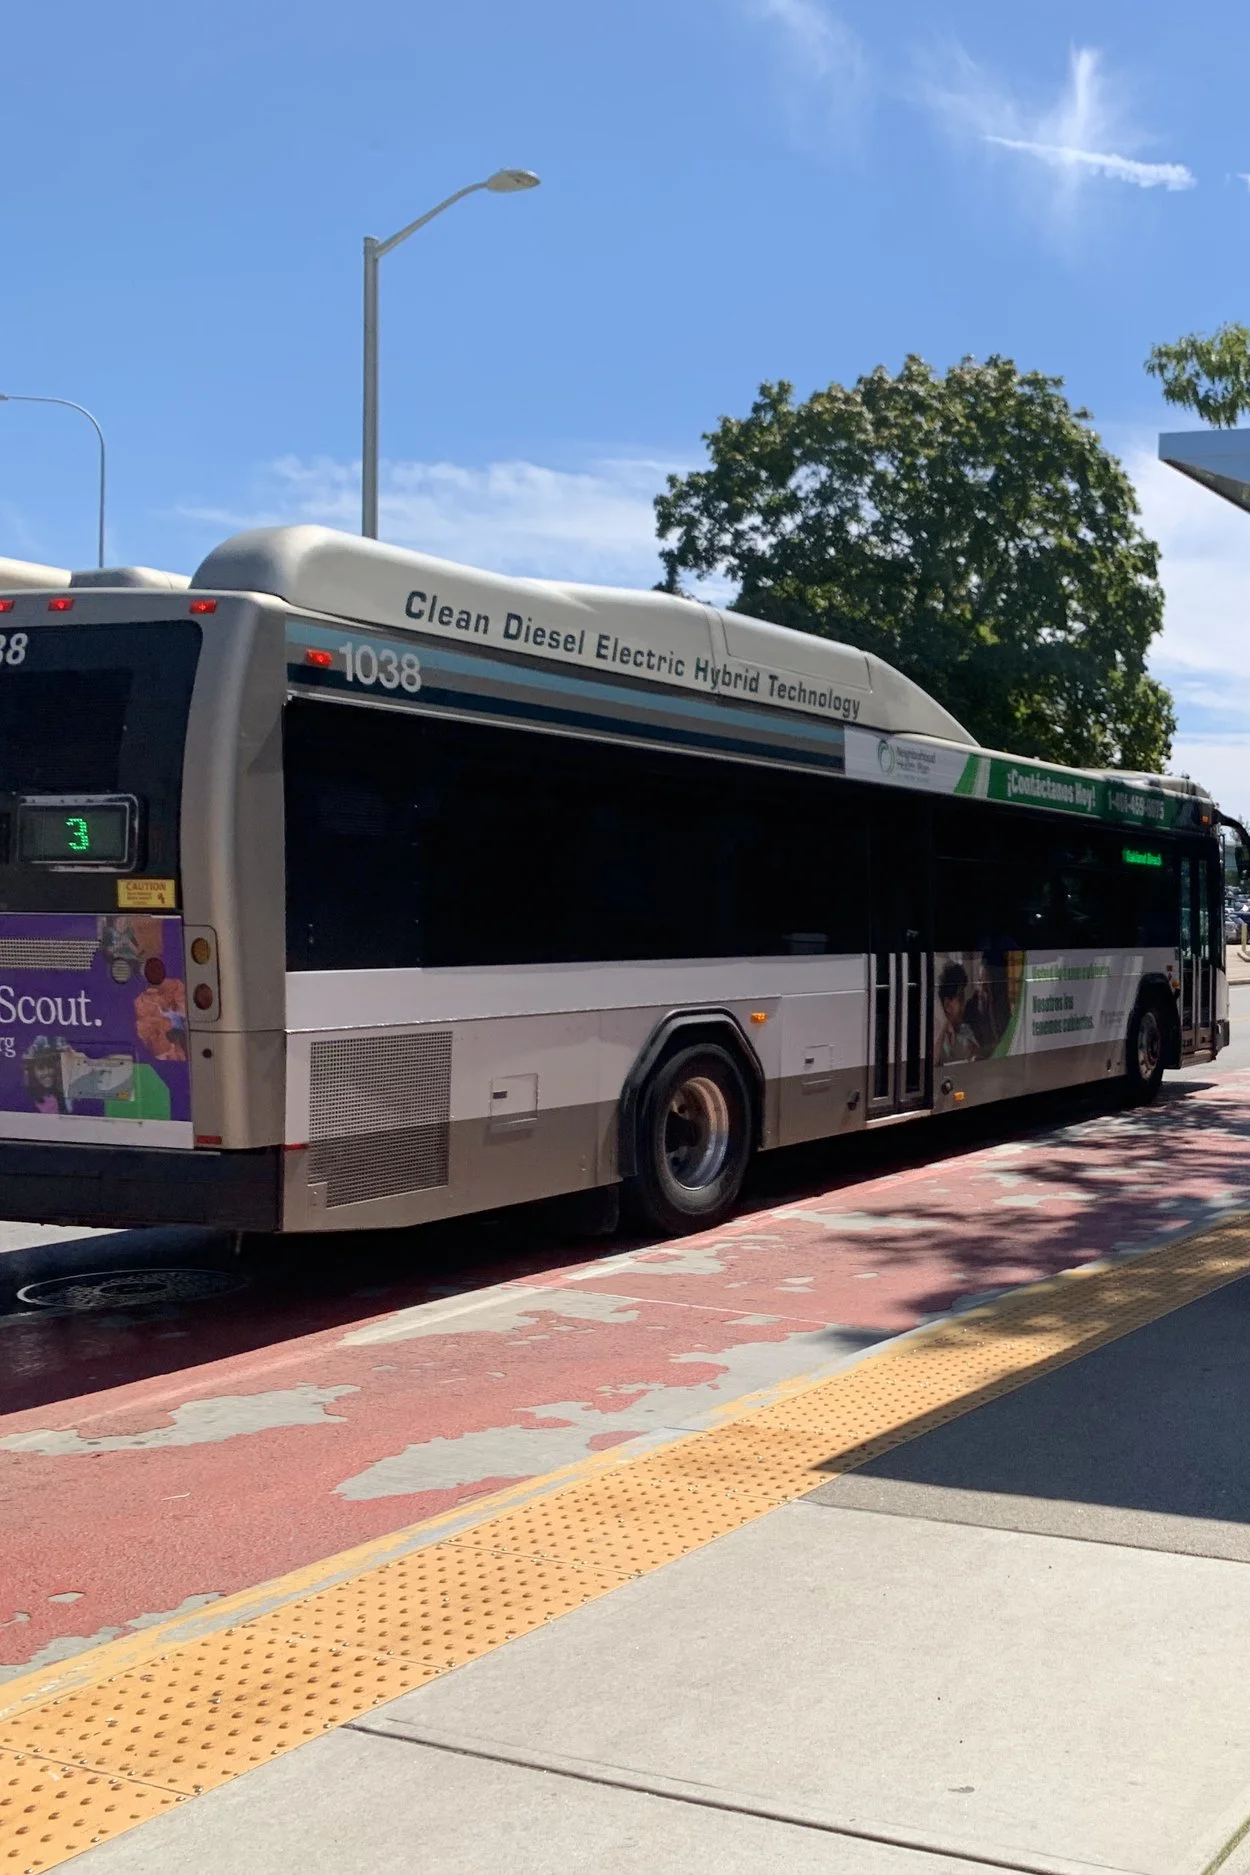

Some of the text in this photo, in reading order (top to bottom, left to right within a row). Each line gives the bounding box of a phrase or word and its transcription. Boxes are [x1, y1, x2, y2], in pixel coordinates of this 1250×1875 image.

[339, 641, 422, 693] 1038
[404, 590, 861, 720] Clean Diesel Electric Hybrid Technology
[65, 817, 89, 851] 3
[126, 881, 166, 891] CAUTION
[0, 985, 102, 1027] Scout.
